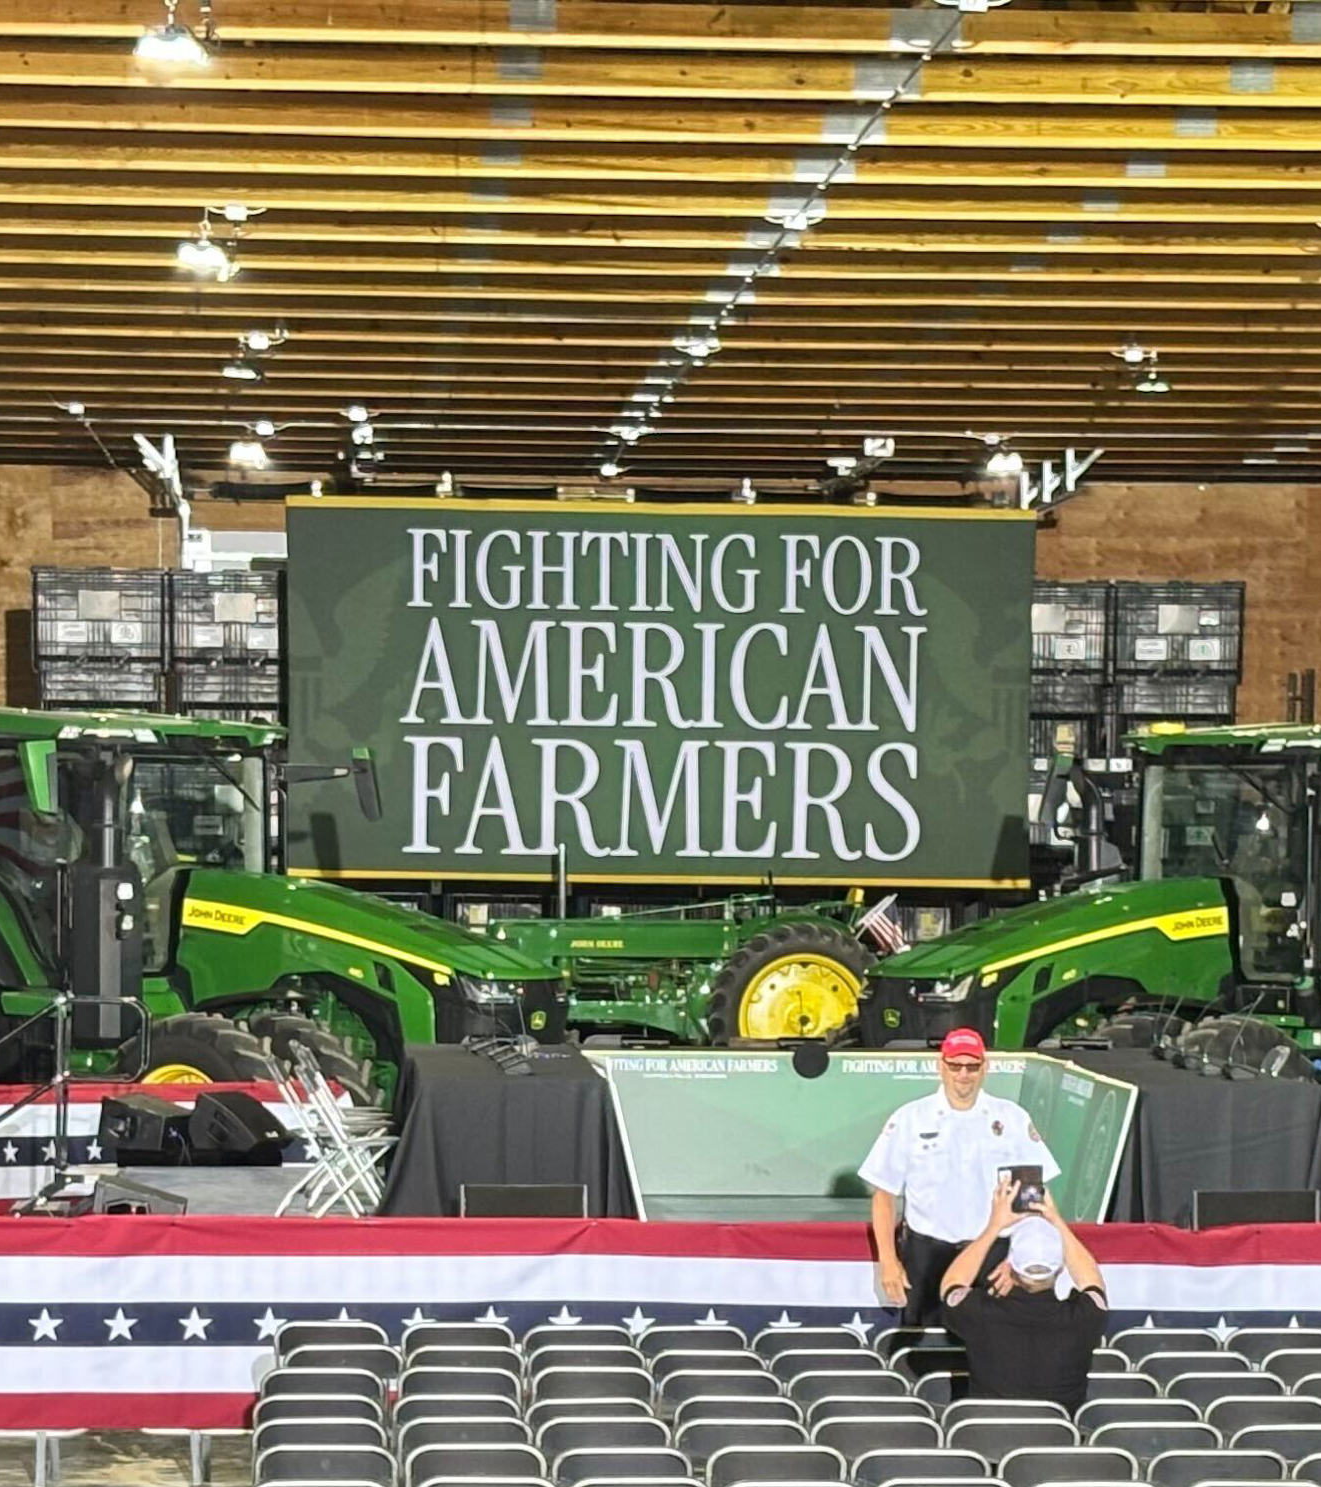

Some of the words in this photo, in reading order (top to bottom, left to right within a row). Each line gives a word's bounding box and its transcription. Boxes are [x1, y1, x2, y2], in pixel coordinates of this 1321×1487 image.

[406, 528, 761, 614] FIGHTING
[778, 534, 928, 617] FOR
[399, 616, 928, 733] AMERICAN
[401, 735, 921, 862] FARMERS
[188, 906, 213, 919] JOHN
[214, 910, 247, 926] DEERE
[1172, 919, 1195, 932] JOHN
[1196, 915, 1224, 929] DEERE
[645, 1058, 668, 1072] FOR
